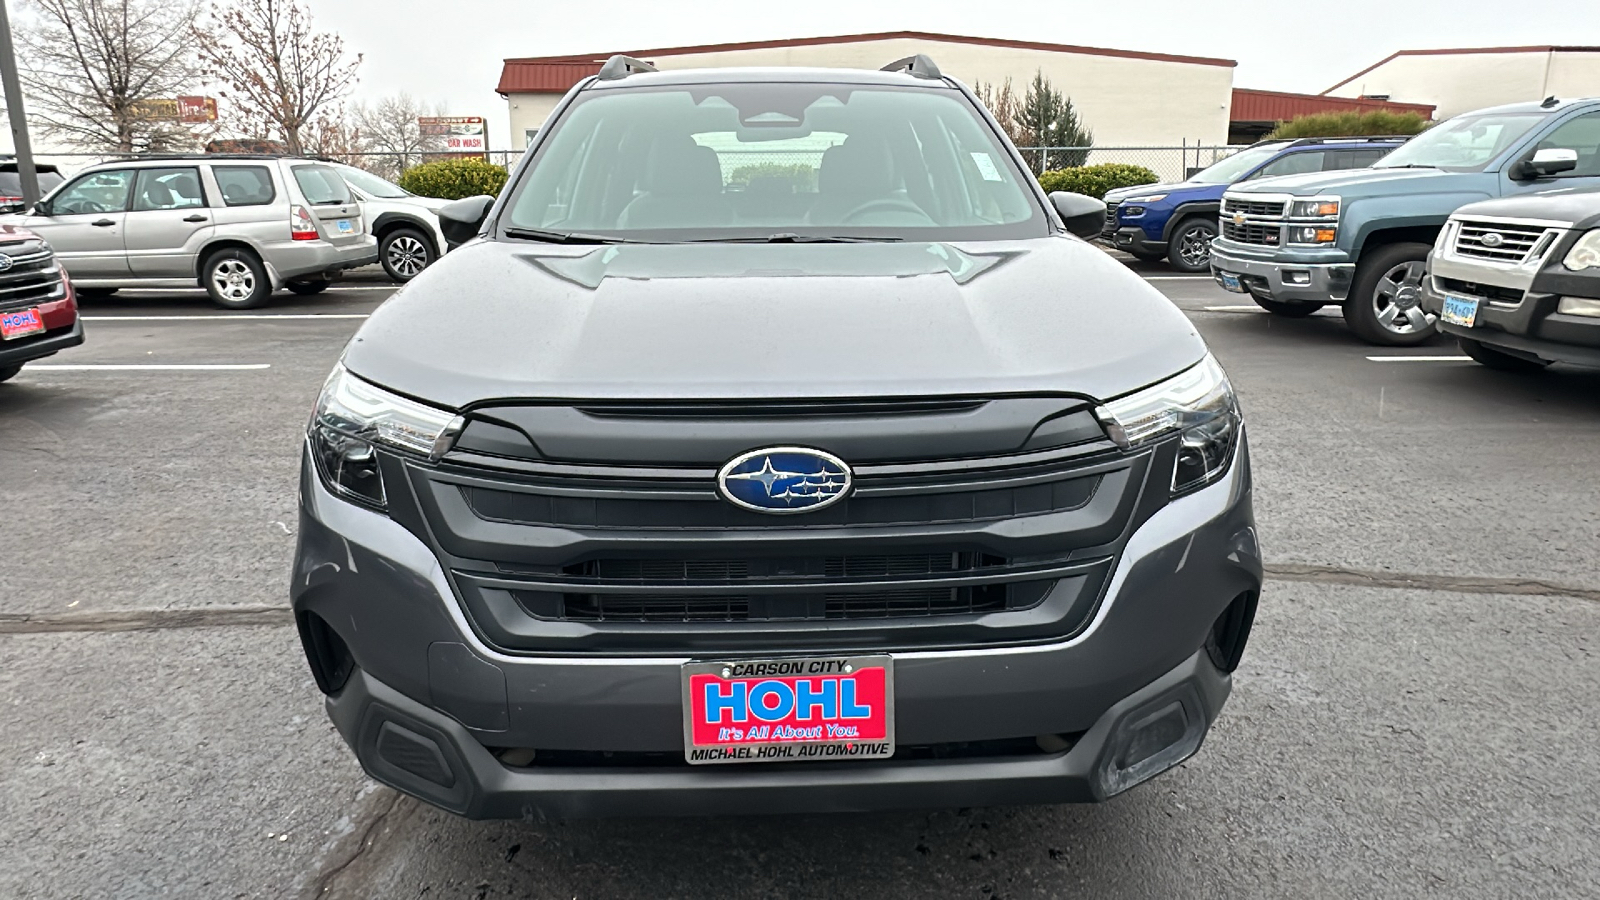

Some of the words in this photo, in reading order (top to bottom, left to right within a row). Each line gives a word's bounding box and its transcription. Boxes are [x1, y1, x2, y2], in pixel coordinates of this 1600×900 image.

[447, 138, 461, 148] CAR
[462, 138, 482, 148] WASH
[2, 313, 37, 327] HOHL
[732, 661, 804, 677] CARSON
[808, 660, 848, 673] CITY
[705, 679, 871, 723] HOHL
[718, 727, 743, 741] It's
[745, 725, 769, 740] All
[771, 724, 823, 739] About
[690, 747, 752, 761] MICHAEL
[757, 746, 795, 759] HOHL
[798, 742, 890, 757] AUTOMOTIVE
